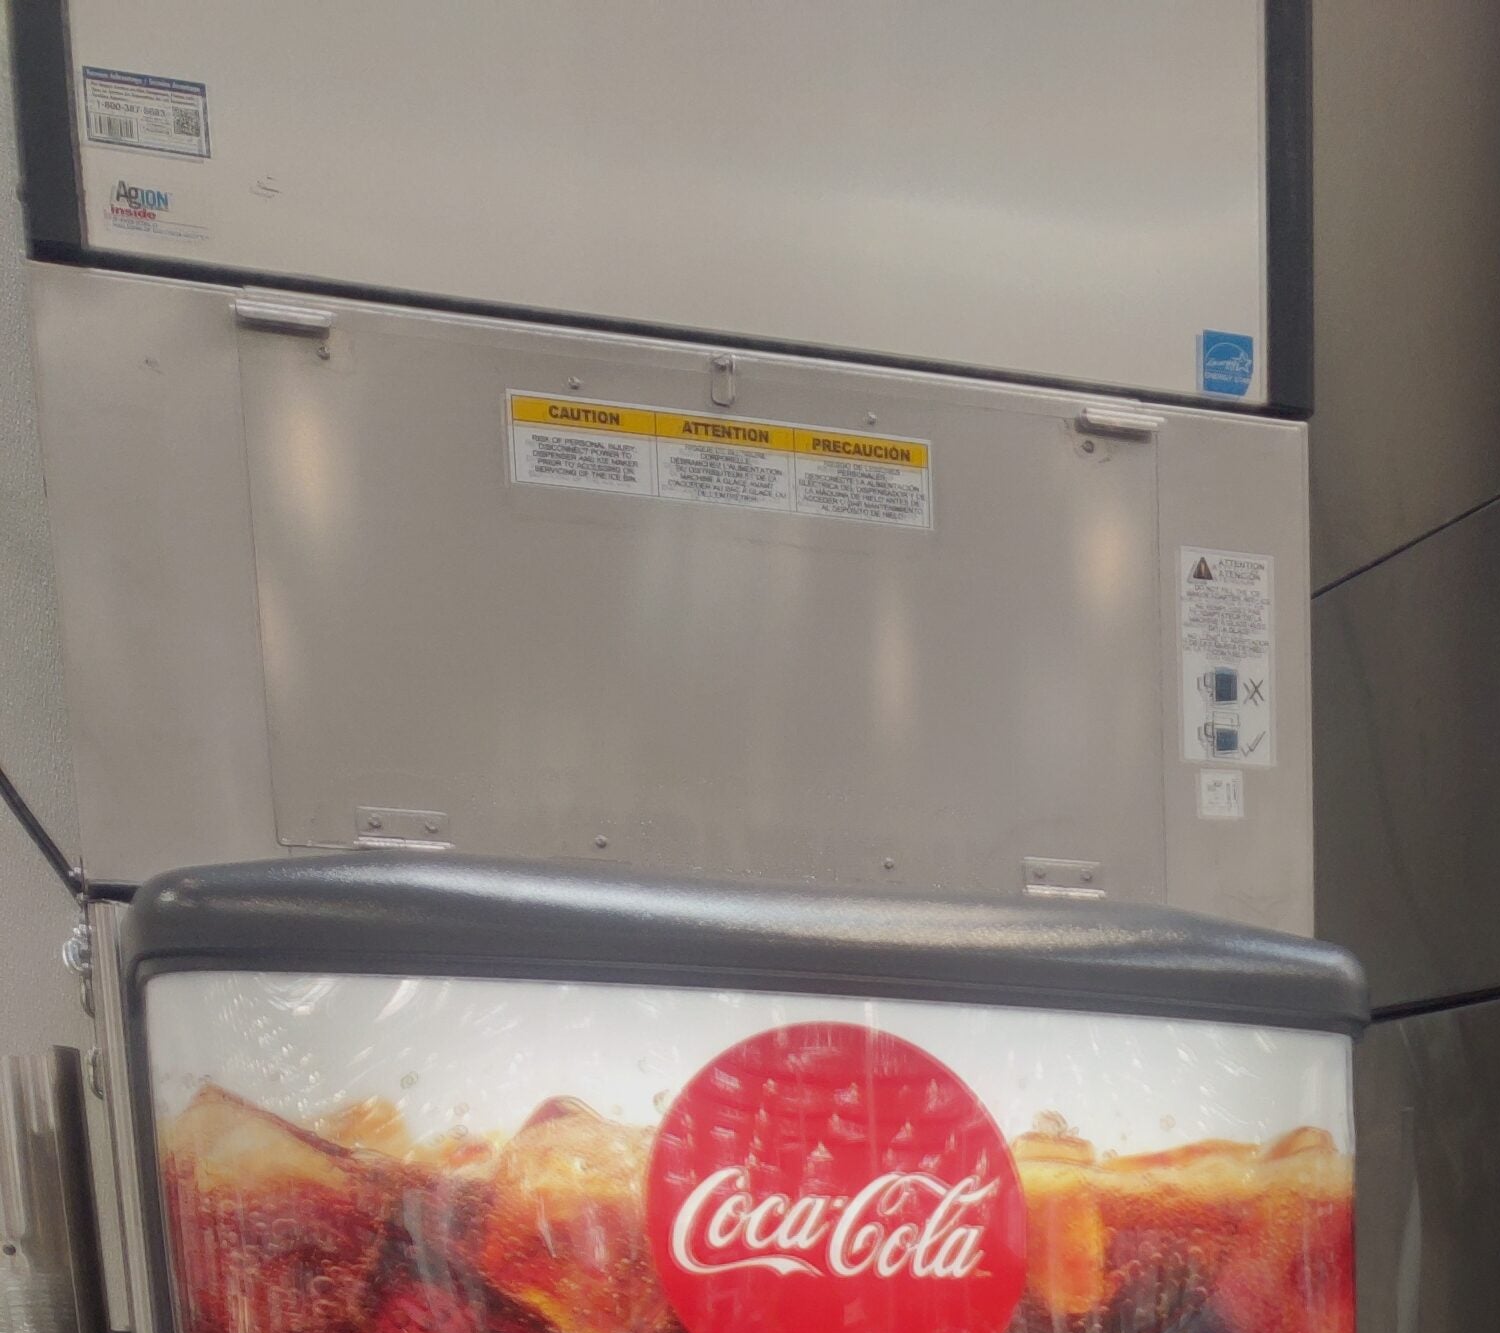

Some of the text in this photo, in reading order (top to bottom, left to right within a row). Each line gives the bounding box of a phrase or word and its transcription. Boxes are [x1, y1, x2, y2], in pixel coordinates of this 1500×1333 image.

[549, 405, 620, 426] CAUTION
[682, 420, 769, 443] ATTENTION
[669, 1165, 1000, 1278] Coca-Cola
